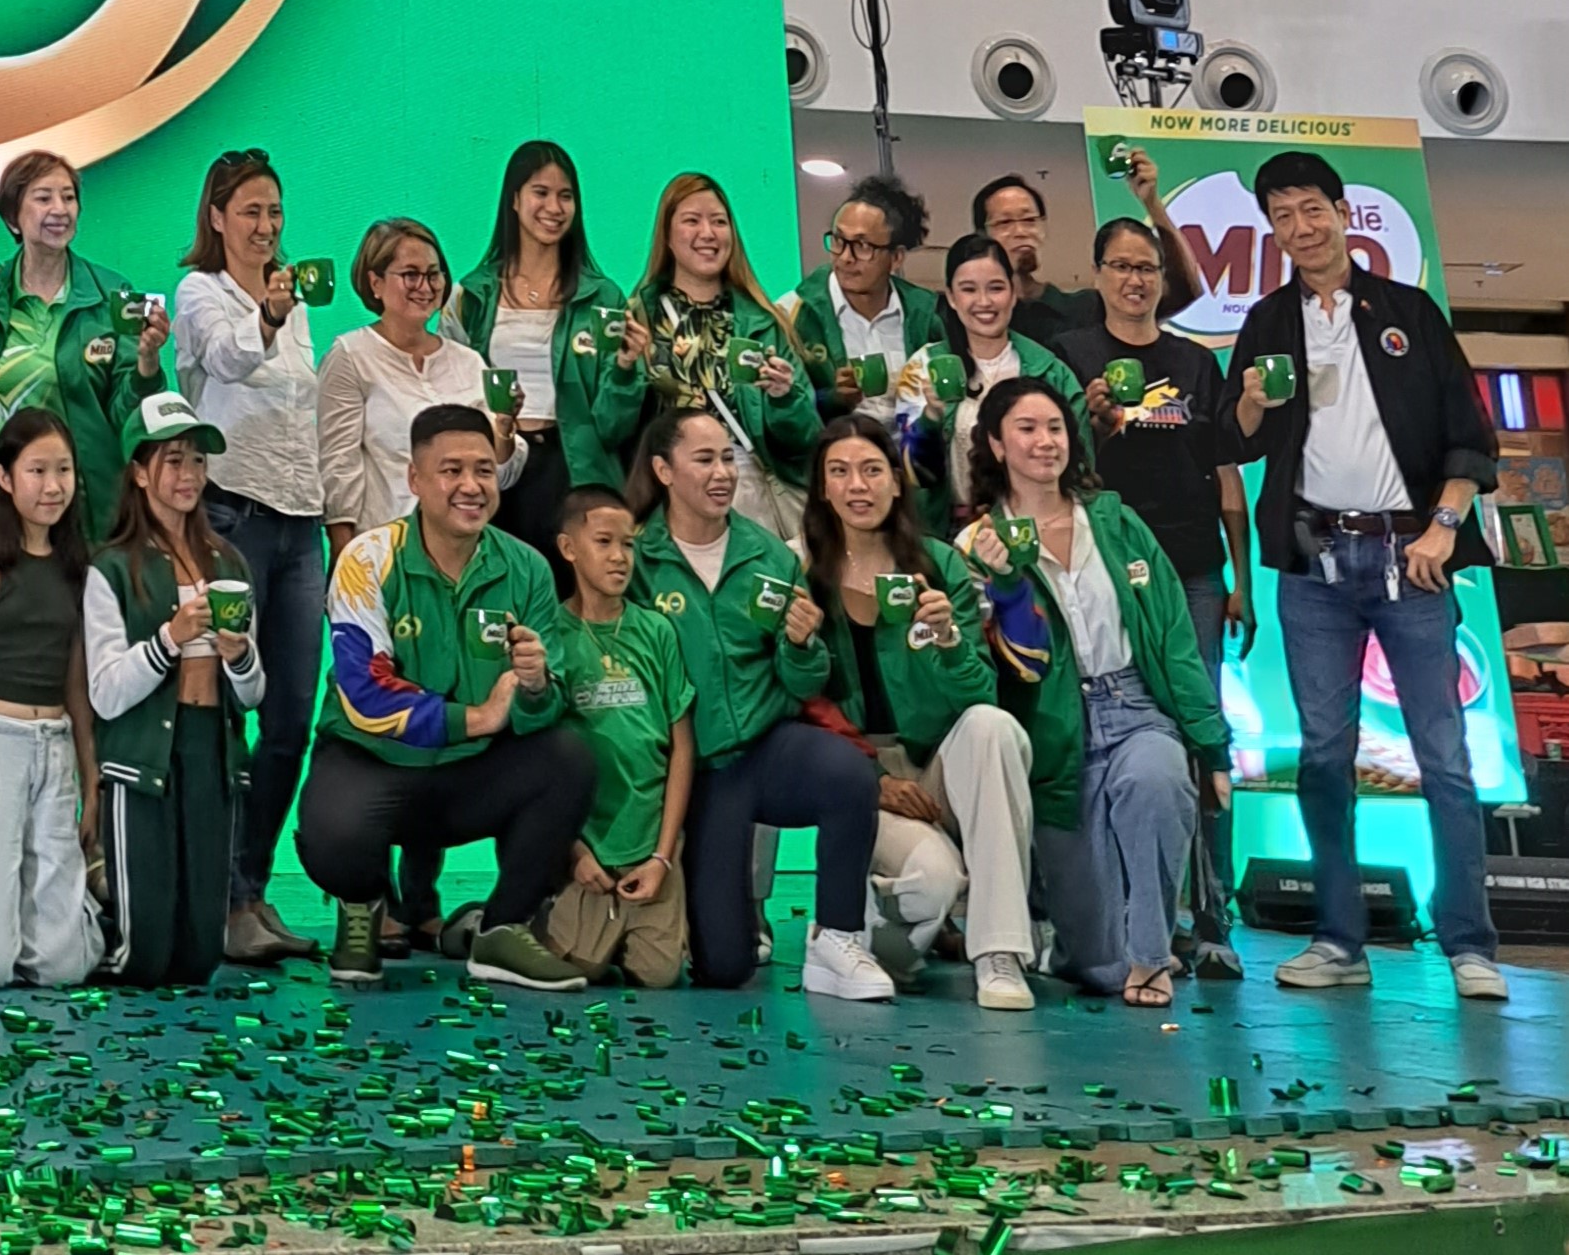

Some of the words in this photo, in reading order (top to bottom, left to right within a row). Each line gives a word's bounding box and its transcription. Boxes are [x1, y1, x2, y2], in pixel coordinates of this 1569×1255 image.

[1150, 115, 1194, 130] NOW
[1200, 117, 1250, 132] MORE
[1256, 119, 1352, 136] DELICIOUS
[224, 598, 246, 618] 60
